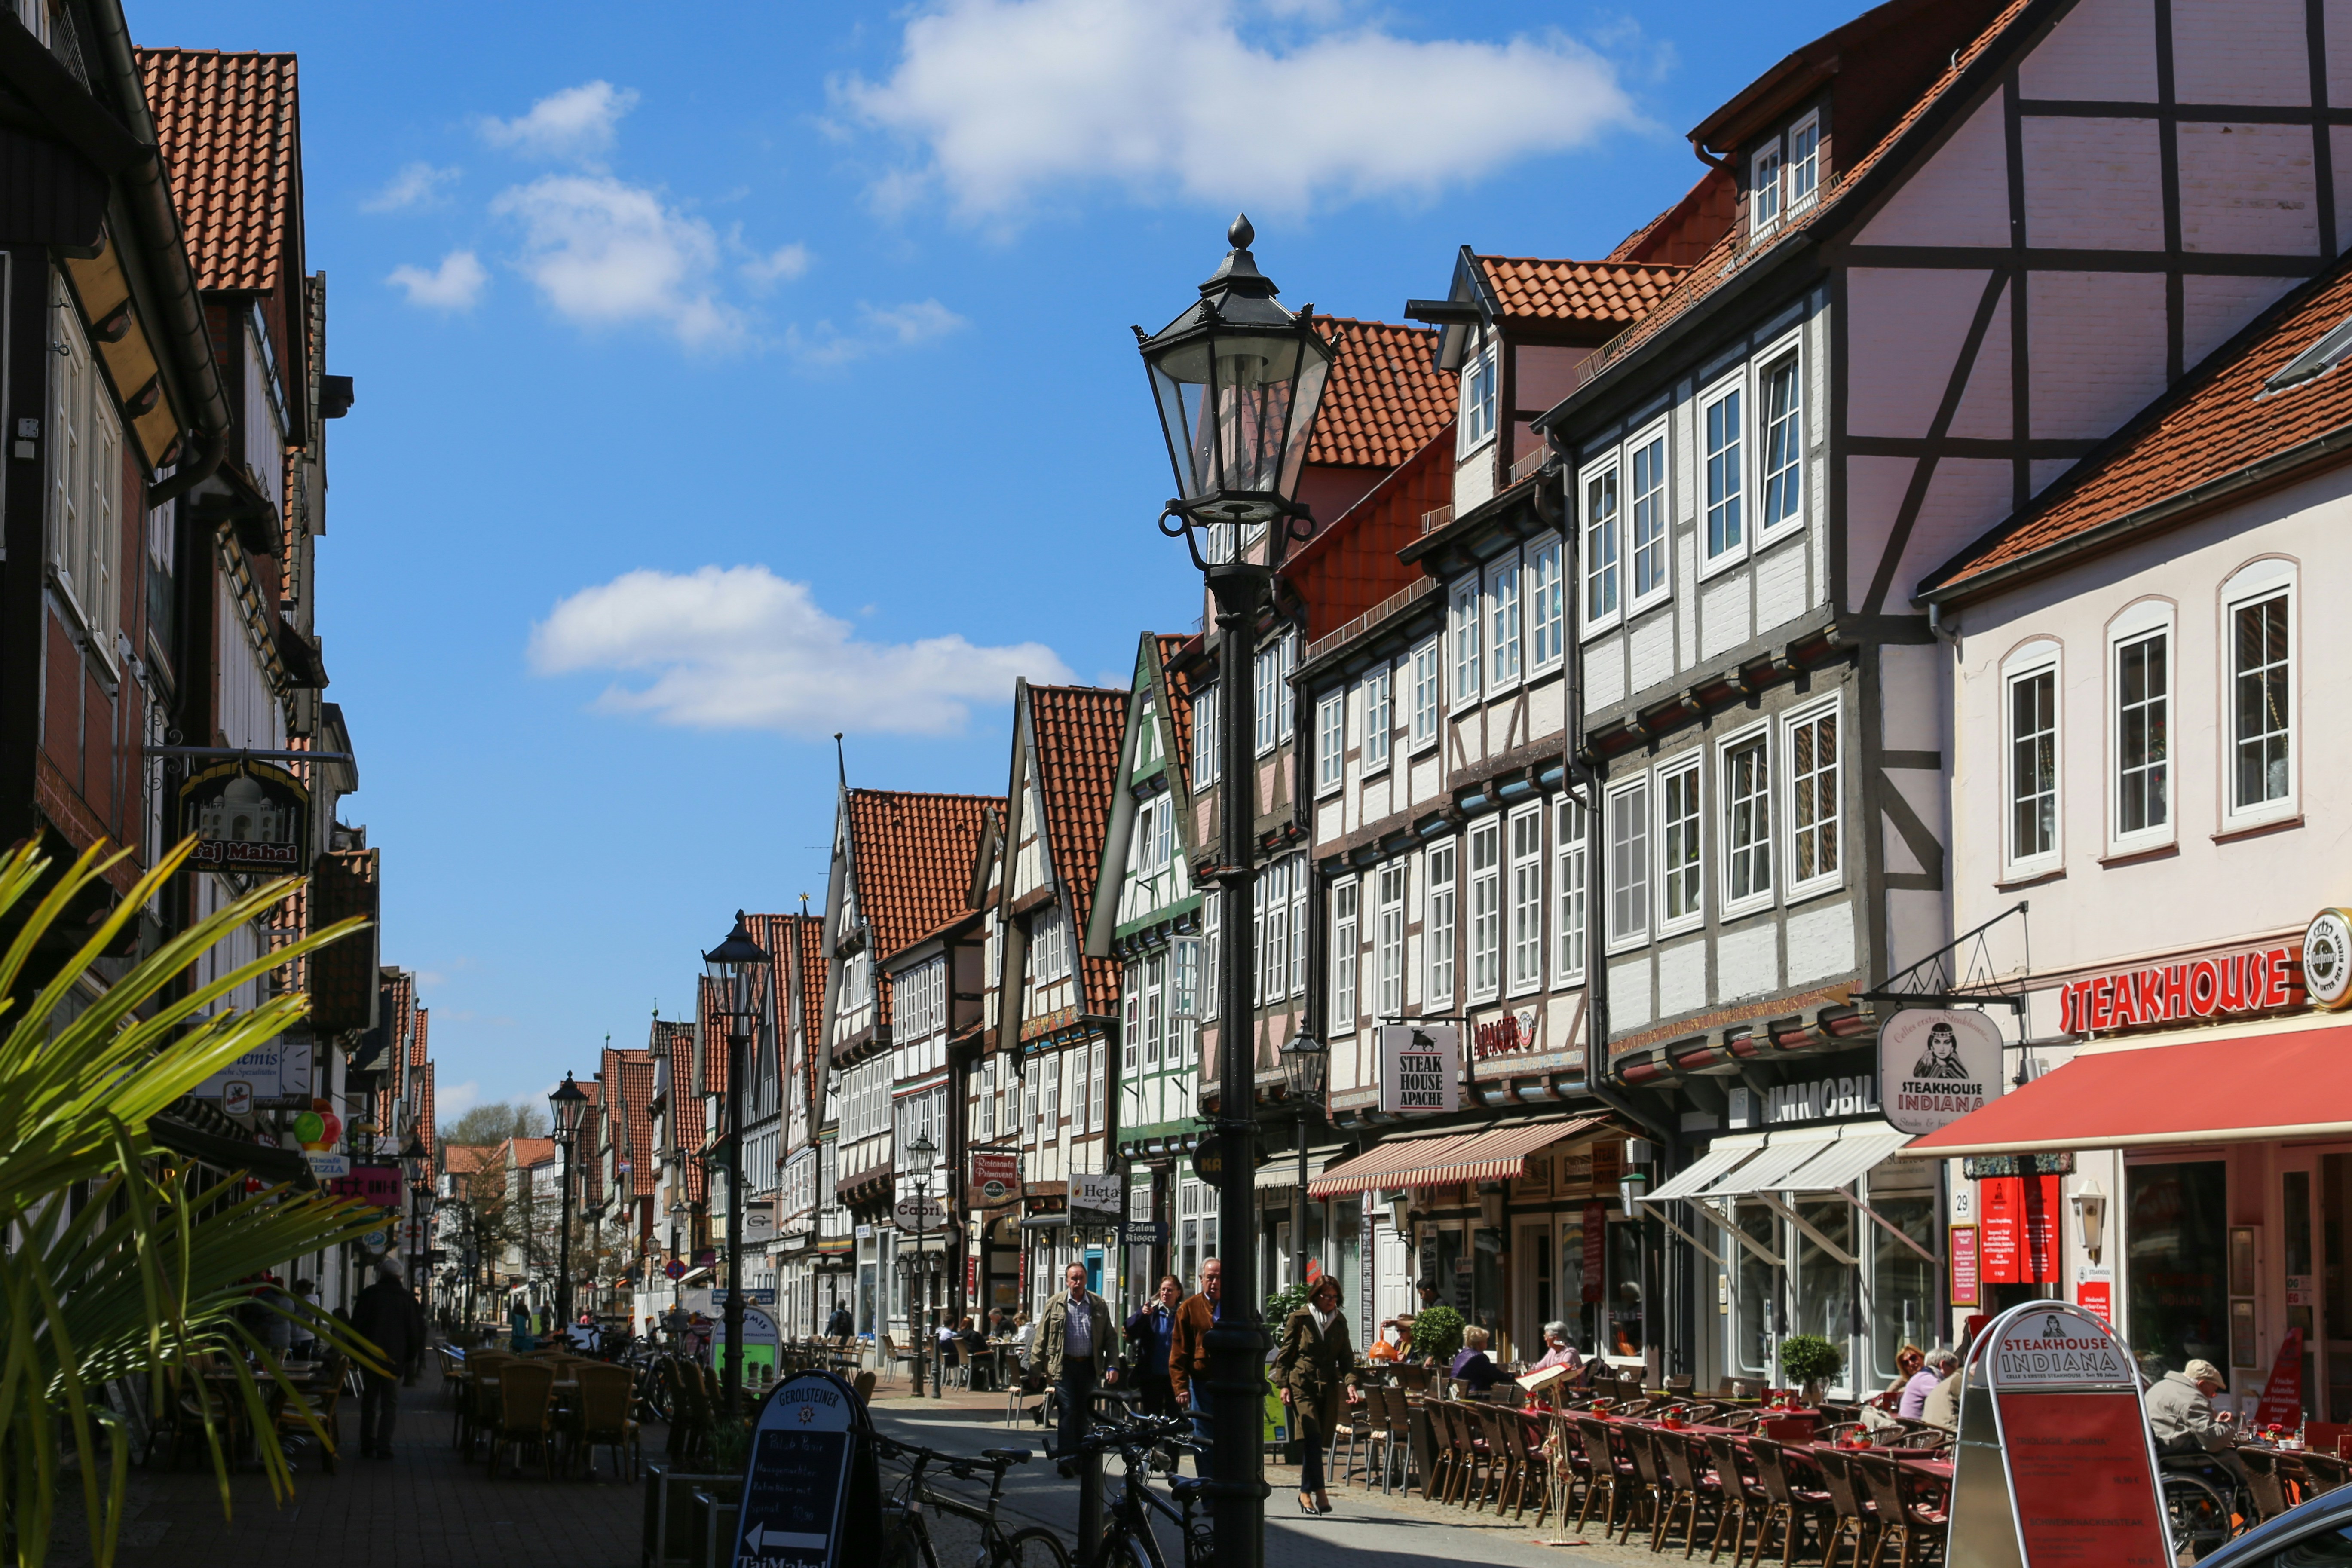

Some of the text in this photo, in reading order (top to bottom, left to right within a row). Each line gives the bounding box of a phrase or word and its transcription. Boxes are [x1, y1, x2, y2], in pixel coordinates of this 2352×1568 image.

[227, 842, 297, 863] Mahal
[229, 863, 283, 873] Restaurant
[2334, 934, 2344, 963] BIEREN
[2334, 966, 2343, 982] DEN
[2059, 947, 2292, 1035] STEAKHOUSE
[2320, 980, 2336, 992] UNTER
[1917, 1015, 1941, 1027] erstes
[1400, 1056, 1442, 1072] STEAK
[1400, 1074, 1443, 1090] HOUSE
[1902, 1081, 1983, 1095] STEAKHOUSE
[1400, 1092, 1443, 1106] APACHE
[1769, 1075, 1880, 1124] IMMOBIL
[1898, 1094, 1986, 1113] INDIANA
[310, 1164, 344, 1173] EZIA
[975, 1157, 1014, 1168] Ristorante
[975, 1168, 1013, 1178] Primavera
[1084, 1185, 1118, 1198] Heta
[1957, 1195, 1968, 1211] 29
[2288, 1293, 2299, 1303] EG
[2005, 1338, 2108, 1351] STEAKHOUSE
[2002, 1353, 2117, 1372] INDIANA
[779, 1388, 839, 1408] GEROLSTEINER
